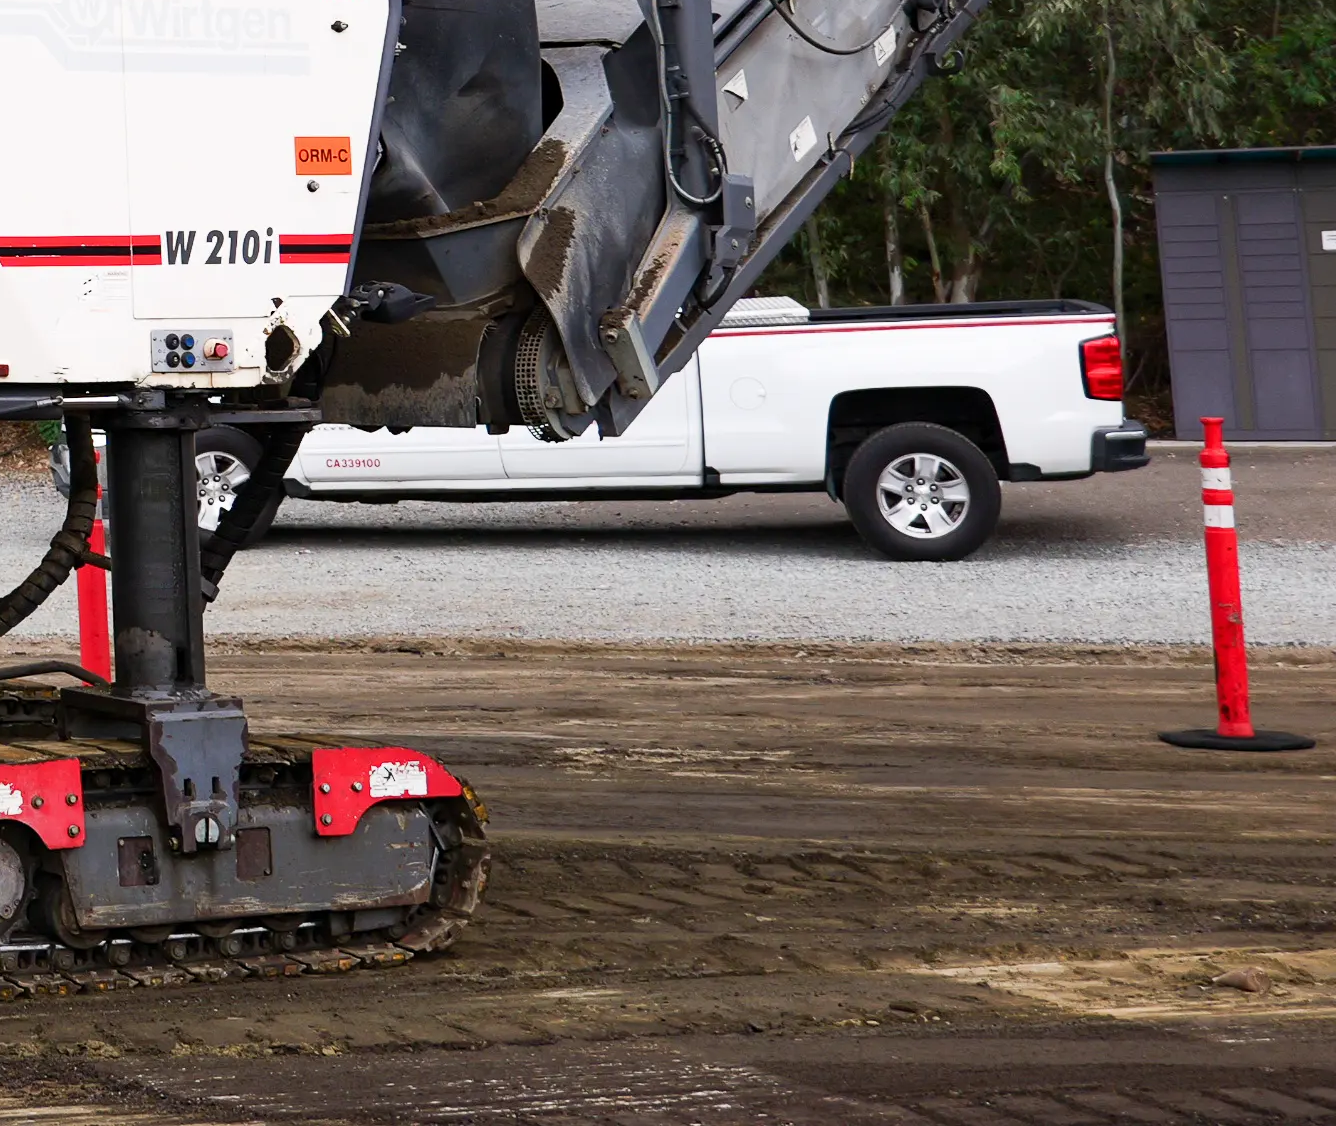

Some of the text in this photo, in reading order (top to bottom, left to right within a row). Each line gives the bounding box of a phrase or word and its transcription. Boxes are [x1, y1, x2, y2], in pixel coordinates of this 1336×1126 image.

[298, 148, 349, 163] ORM-C
[166, 227, 273, 265] W 210i
[326, 459, 381, 468] CA339100
